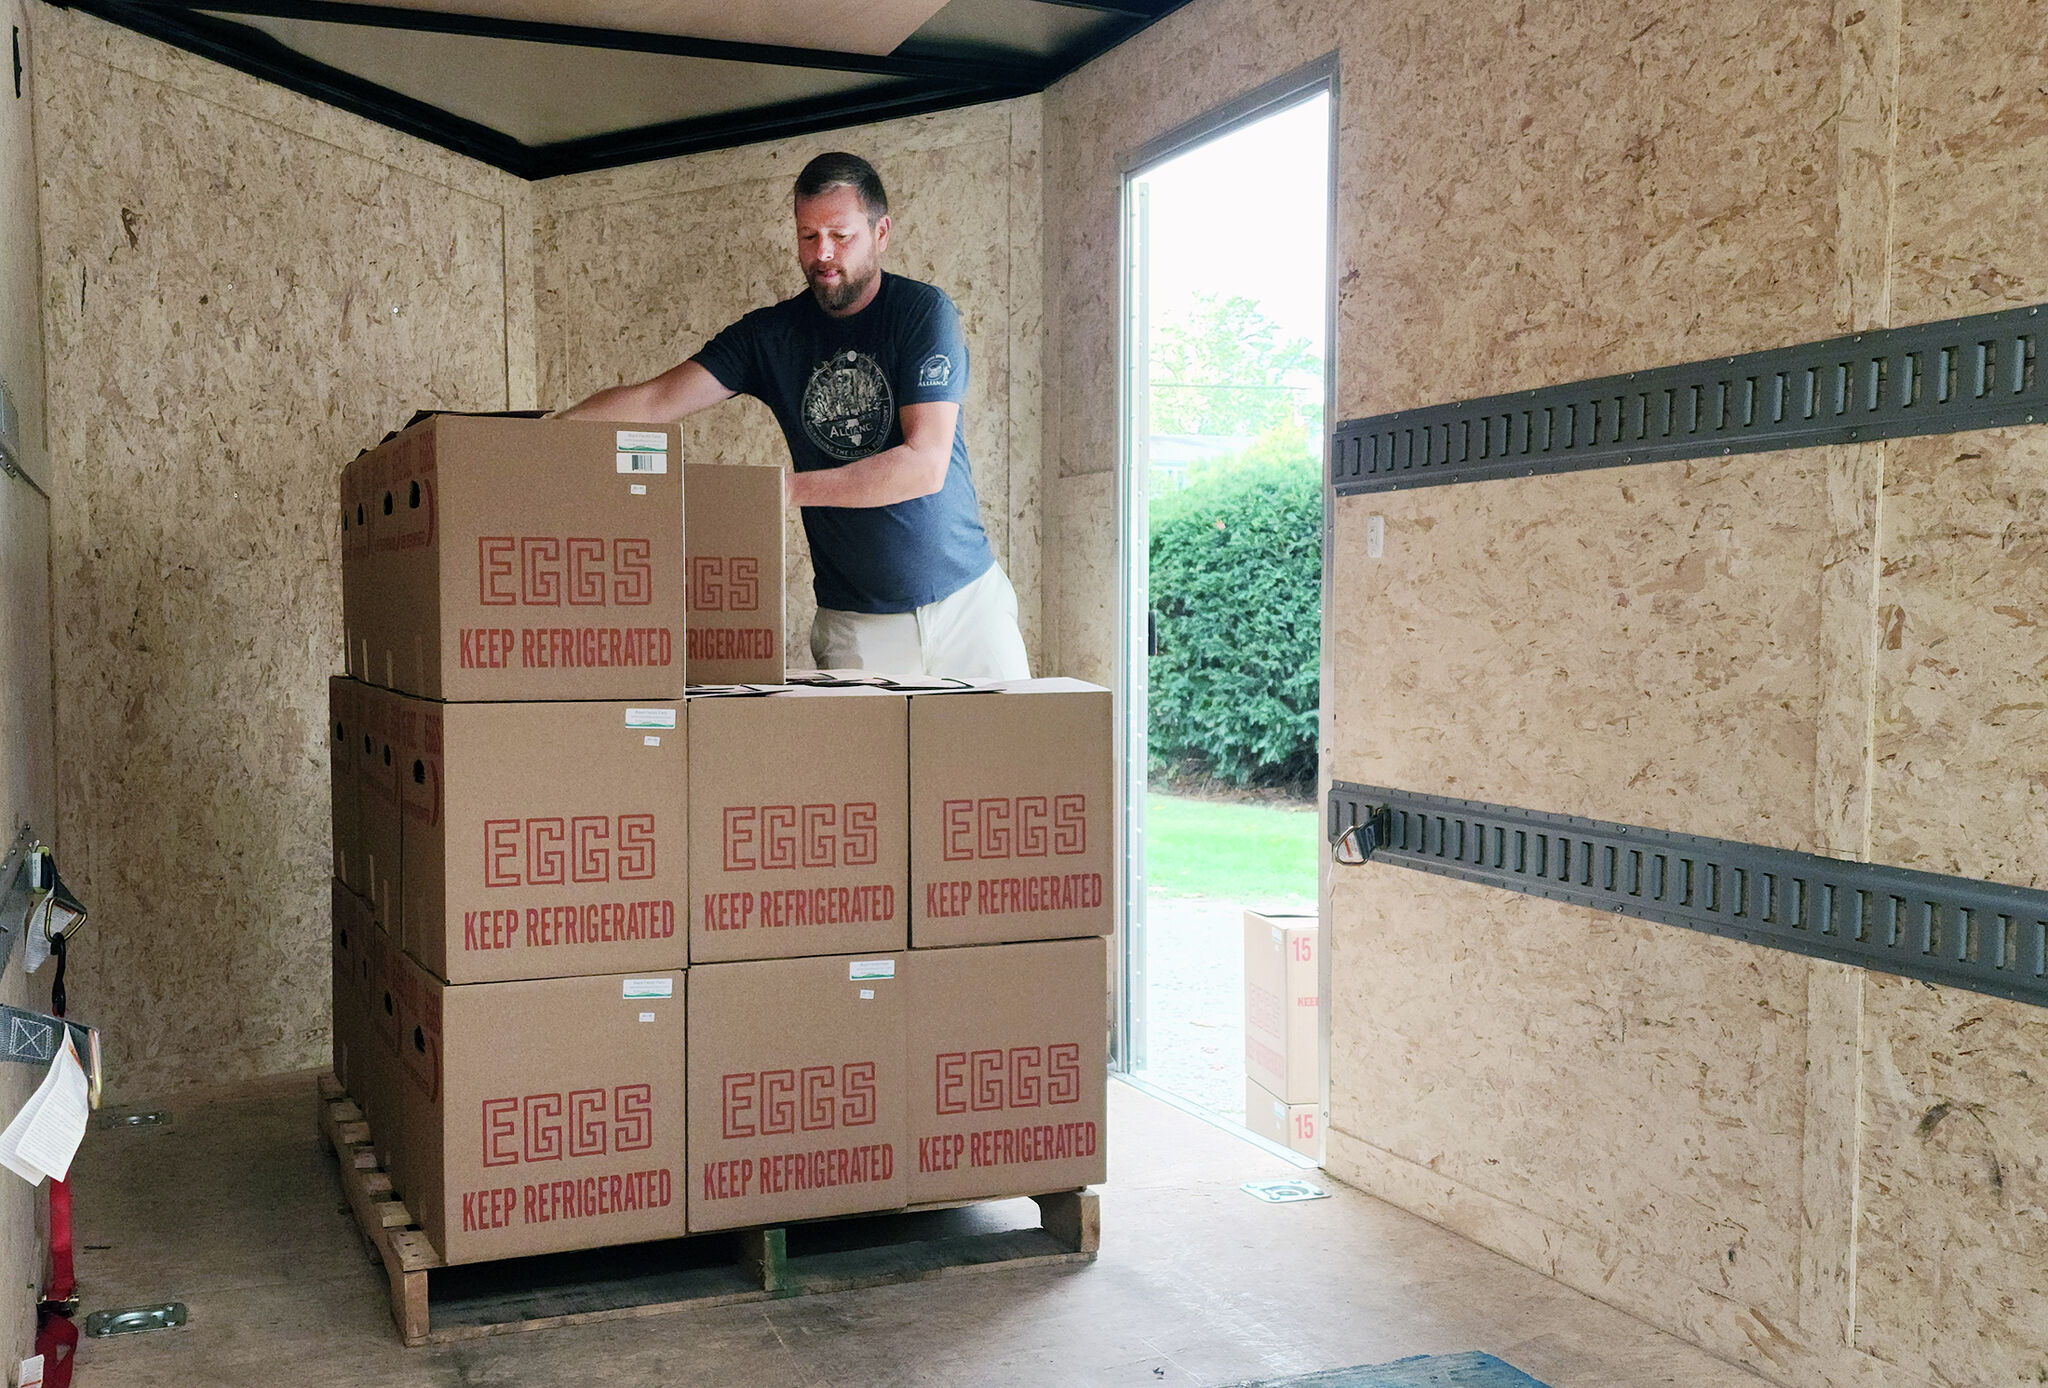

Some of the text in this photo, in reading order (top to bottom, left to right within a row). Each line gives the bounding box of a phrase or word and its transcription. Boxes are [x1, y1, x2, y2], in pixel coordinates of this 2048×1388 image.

[829, 423, 874, 438] ALLIANC
[479, 537, 651, 606] EGGS
[686, 556, 758, 611] GS
[460, 628, 671, 668] KEEP REFRIGERATED
[688, 628, 773, 660] RIGERATED
[484, 814, 655, 888] EGGS
[724, 802, 877, 871] EGGS
[943, 795, 1085, 861] EGGS
[705, 885, 894, 930] KEEP REFRIGERATED
[927, 874, 1102, 917] KEEP REFRIGERATED
[465, 901, 674, 950] KEEP REFRIGERATED
[1292, 937, 1311, 961] 15
[722, 1062, 876, 1139] EGGS
[936, 1044, 1079, 1115] EGGS
[482, 1084, 652, 1167] EGGS
[919, 1122, 1095, 1171] KEEP REFRIGERATED
[1296, 1114, 1313, 1139] 15
[704, 1144, 893, 1199] KEEP REFRIGERATED
[463, 1169, 671, 1231] KEEP REFRIGERATED
